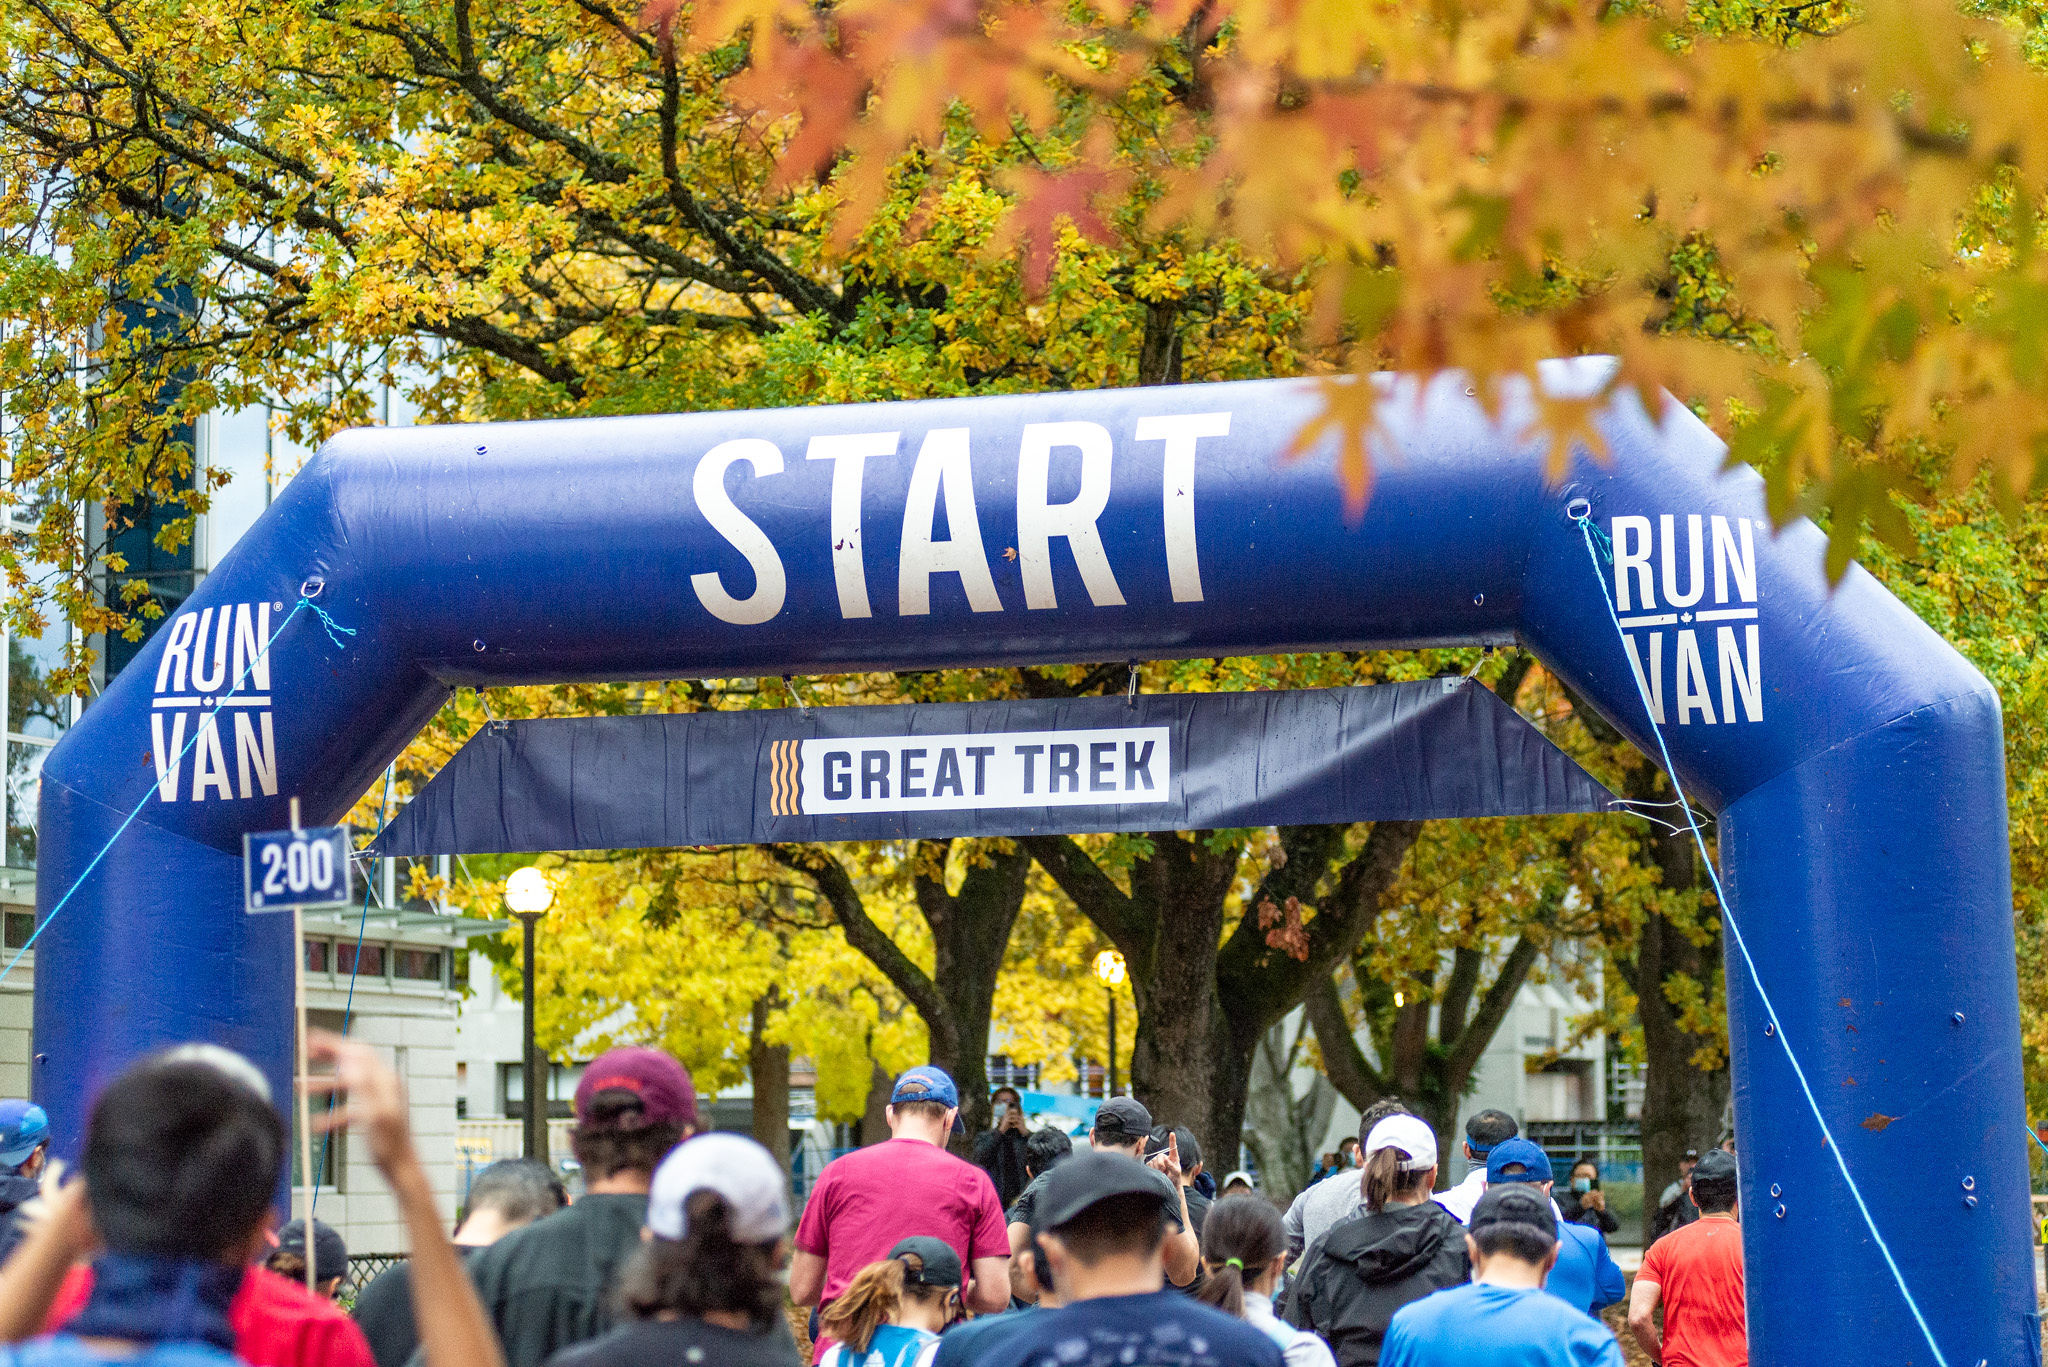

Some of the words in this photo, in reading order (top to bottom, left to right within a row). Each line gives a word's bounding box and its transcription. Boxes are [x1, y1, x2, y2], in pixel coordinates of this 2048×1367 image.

[690, 411, 1233, 626] START
[1612, 514, 1759, 612] RUN
[154, 602, 272, 692] RUN
[1621, 623, 1763, 725] VAN
[150, 711, 279, 803] VAN
[822, 746, 996, 801] GREAT
[1014, 739, 1156, 794] TREK
[260, 838, 335, 896] 2:00
